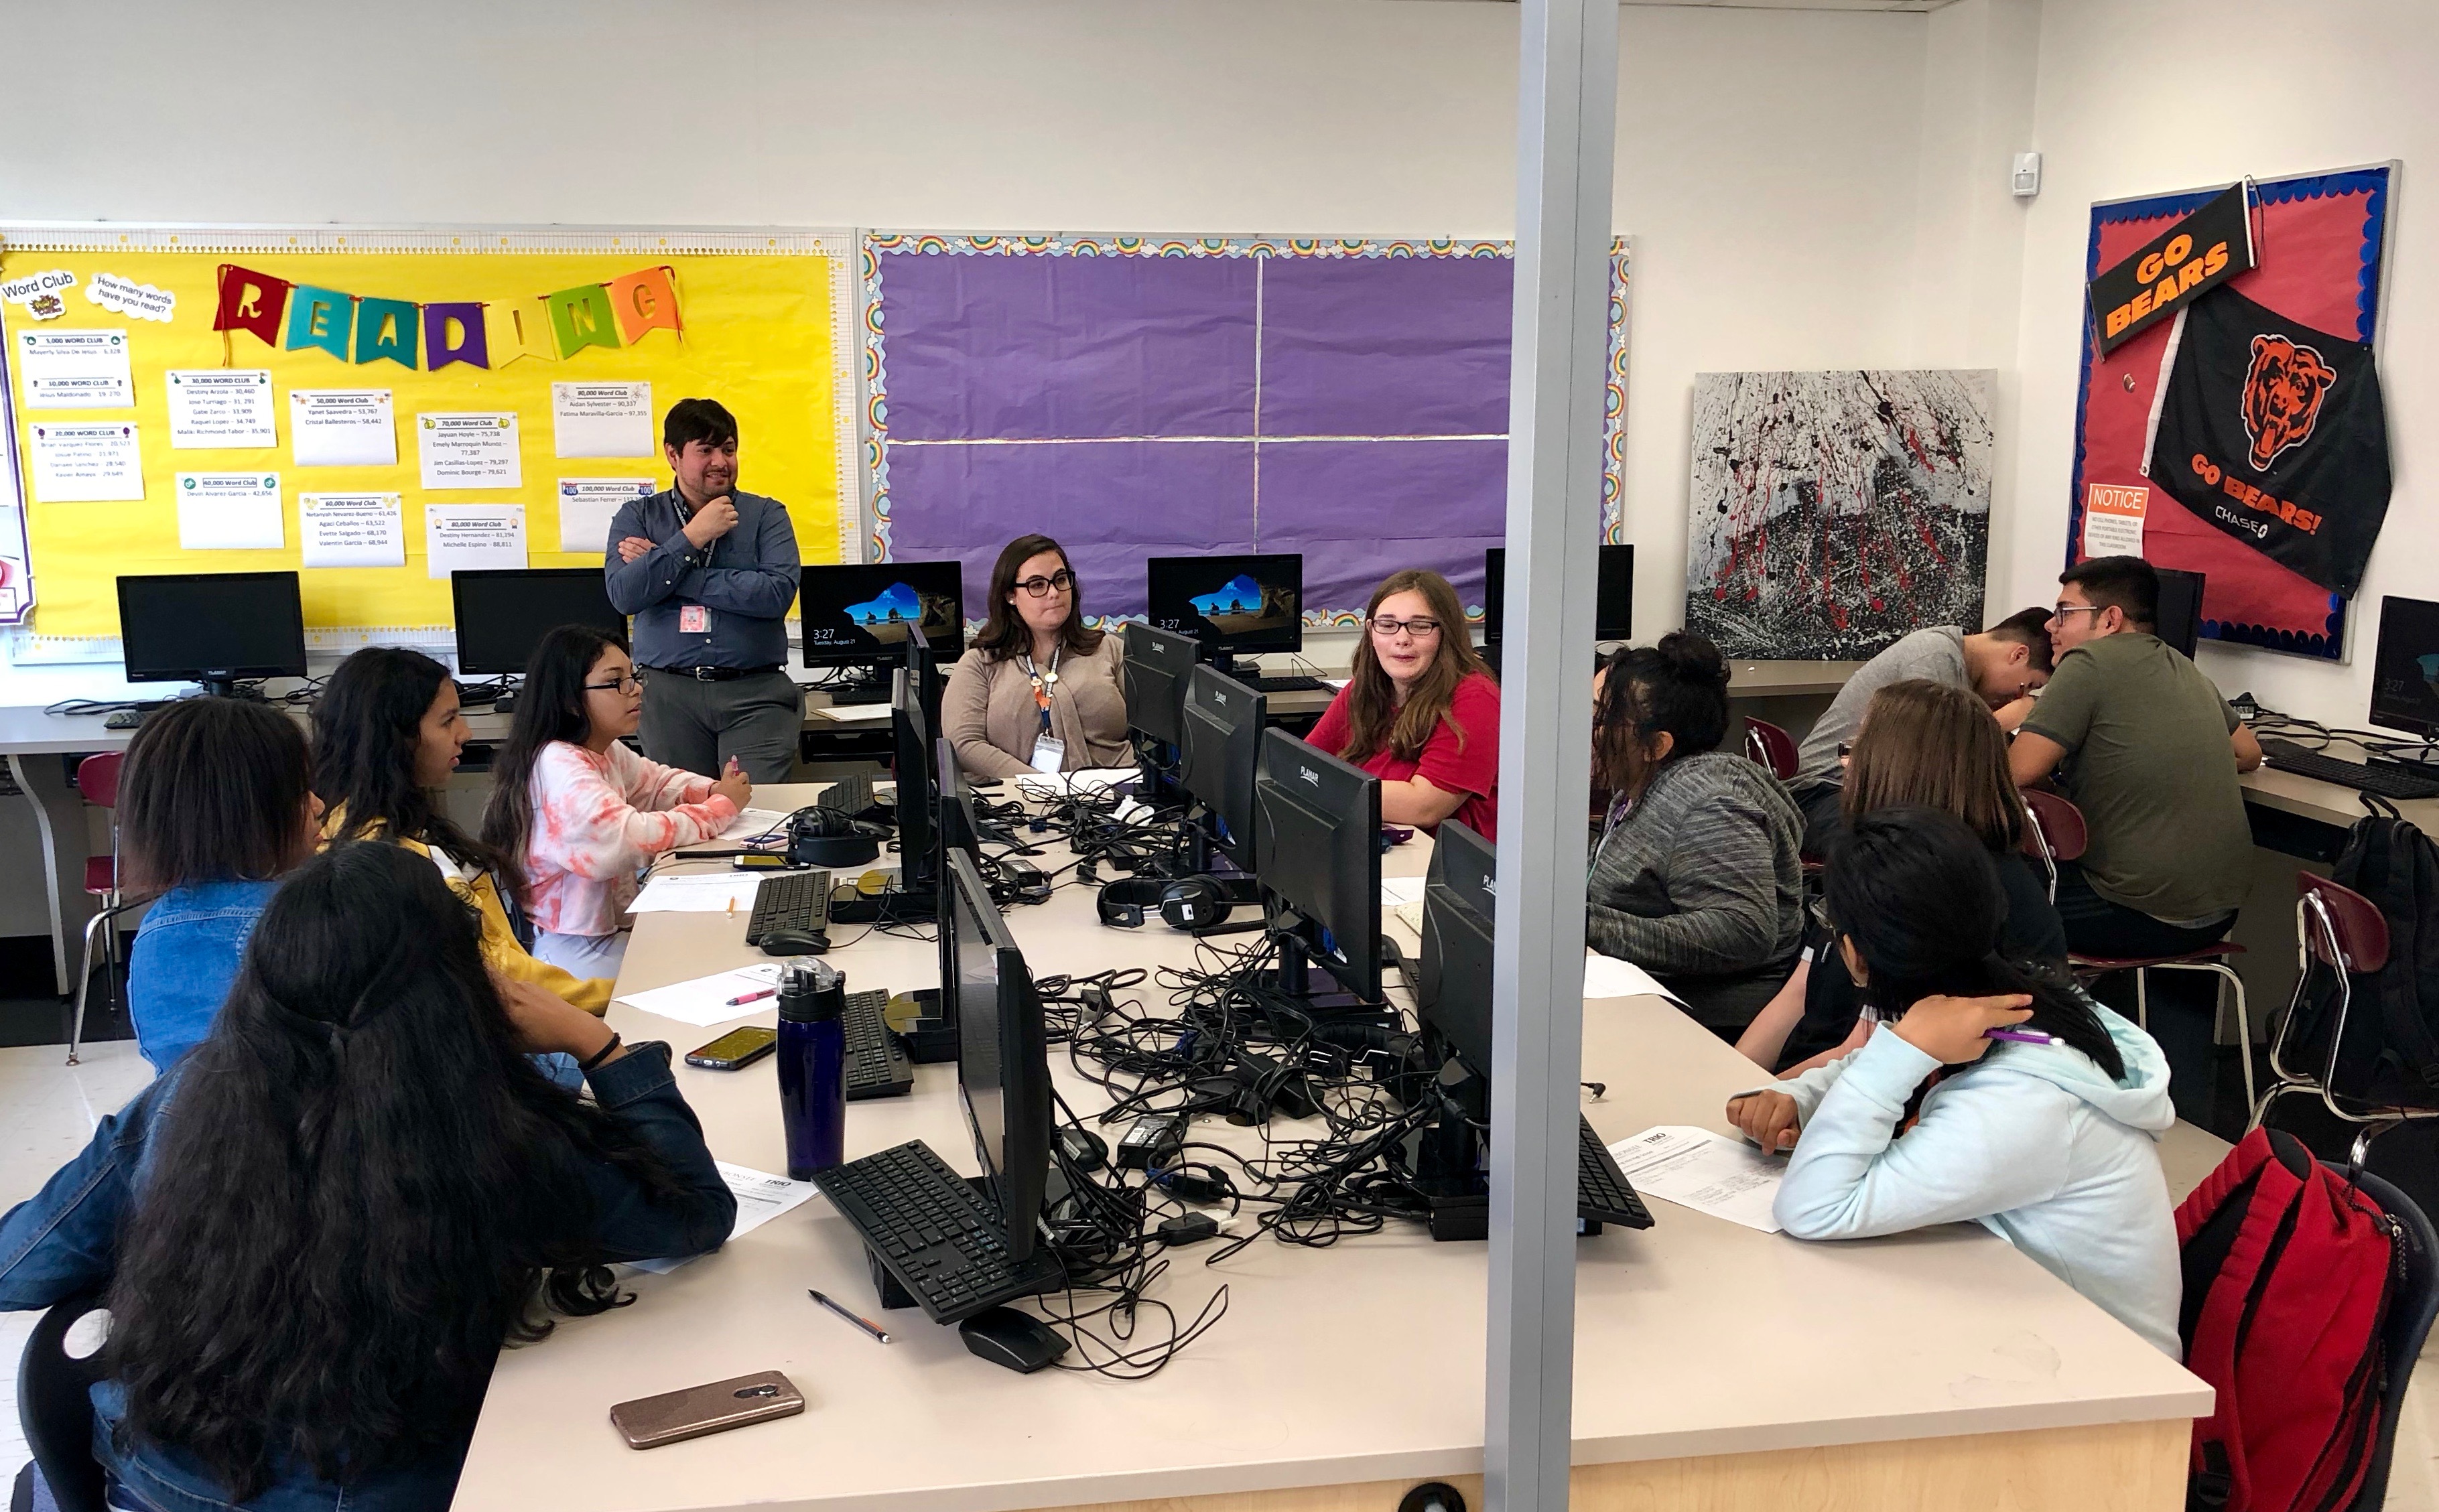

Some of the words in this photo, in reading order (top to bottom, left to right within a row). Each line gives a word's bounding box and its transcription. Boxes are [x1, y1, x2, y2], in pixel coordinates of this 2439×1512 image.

[2136, 233, 2194, 285] GO
[3, 280, 40, 298] Word
[42, 272, 73, 289] Club
[97, 276, 118, 289] How
[119, 283, 143, 297] many
[145, 292, 172, 304] words
[2105, 241, 2231, 339] BEARS
[98, 289, 121, 301] have
[122, 296, 139, 307] you
[140, 301, 166, 314] read?
[2094, 488, 2143, 509] NOTICE
[2191, 454, 2221, 485] GO
[2223, 475, 2322, 535] BEARS!
[2215, 505, 2259, 533] CHASE
[813, 629, 834, 639] 3:27
[1160, 619, 1179, 629] 3:27
[1301, 766, 1319, 782] PLANAR
[1642, 1133, 1666, 1143] TRIO
